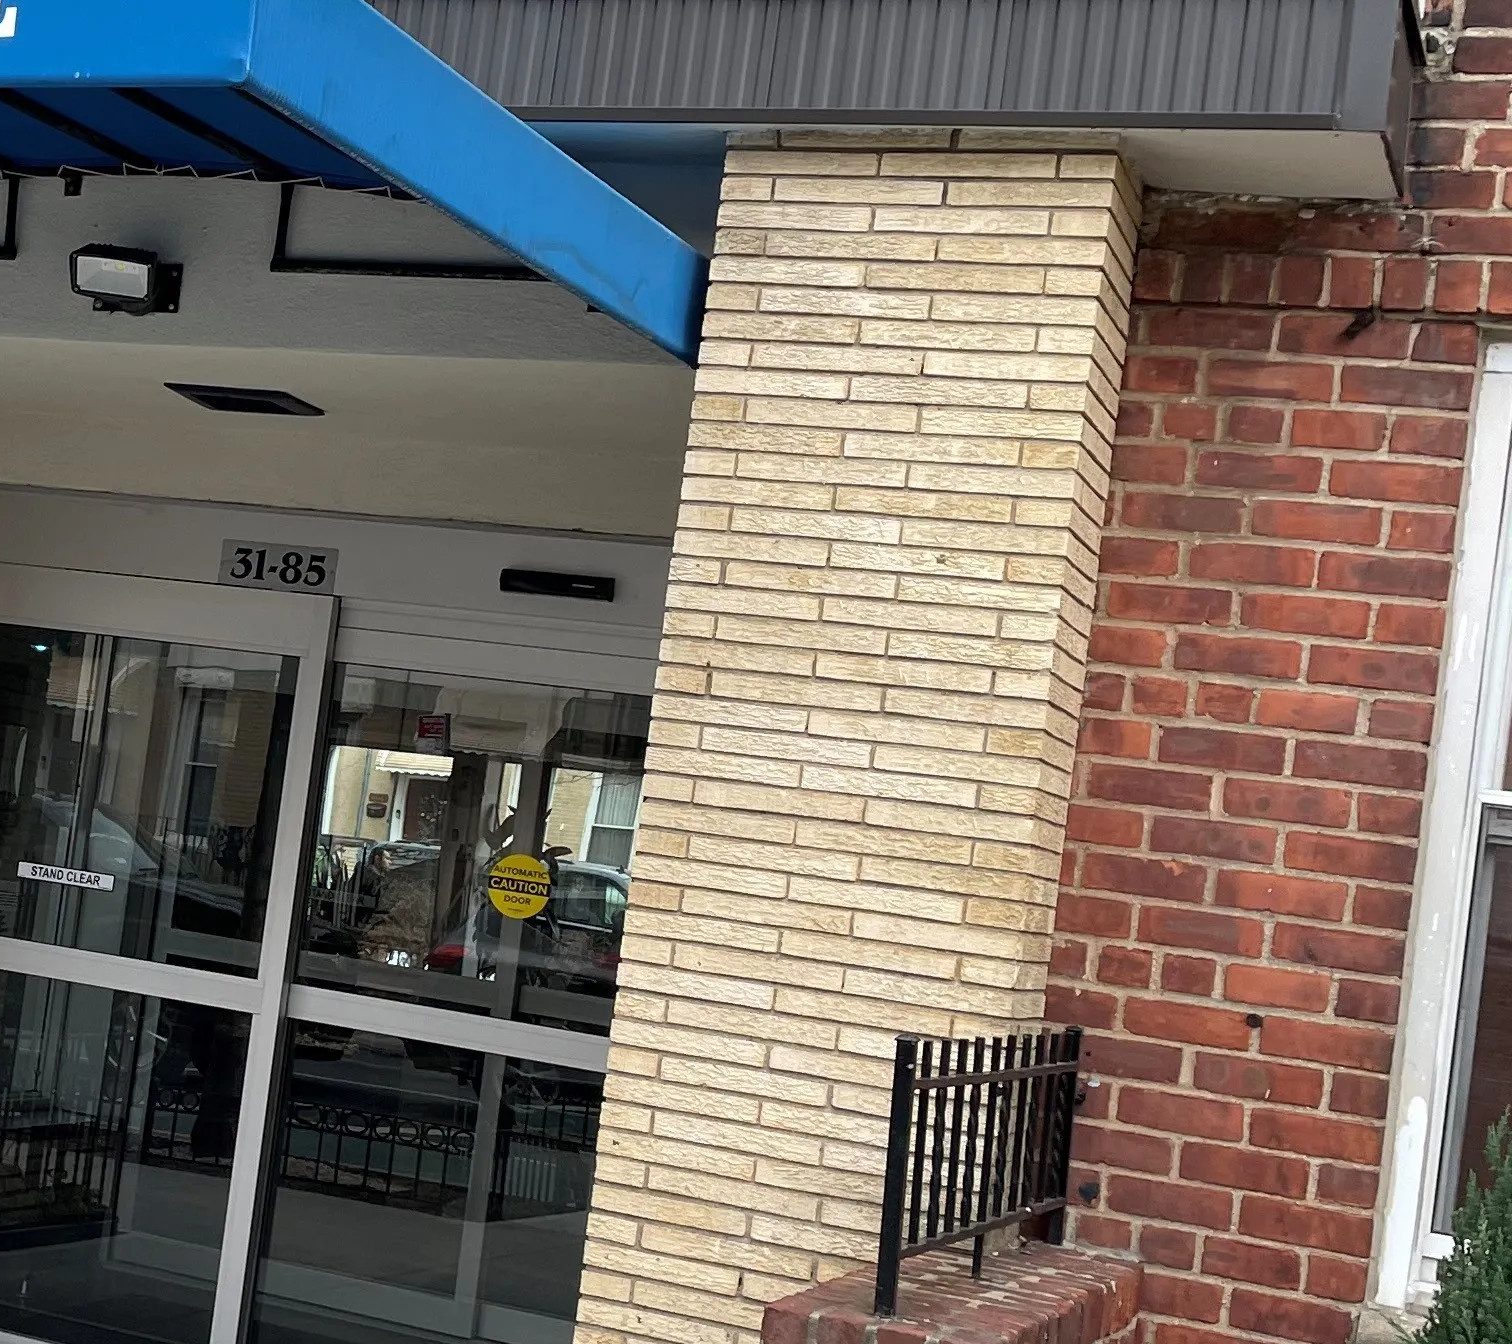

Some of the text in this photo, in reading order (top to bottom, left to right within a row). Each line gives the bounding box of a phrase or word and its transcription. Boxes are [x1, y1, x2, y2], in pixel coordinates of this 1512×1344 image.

[229, 546, 327, 587] 31-85
[31, 865, 101, 887] STAND CLEAR
[494, 865, 548, 879] AUTOMATIC
[490, 877, 548, 895] CAUTION
[503, 894, 531, 905] DOOR
